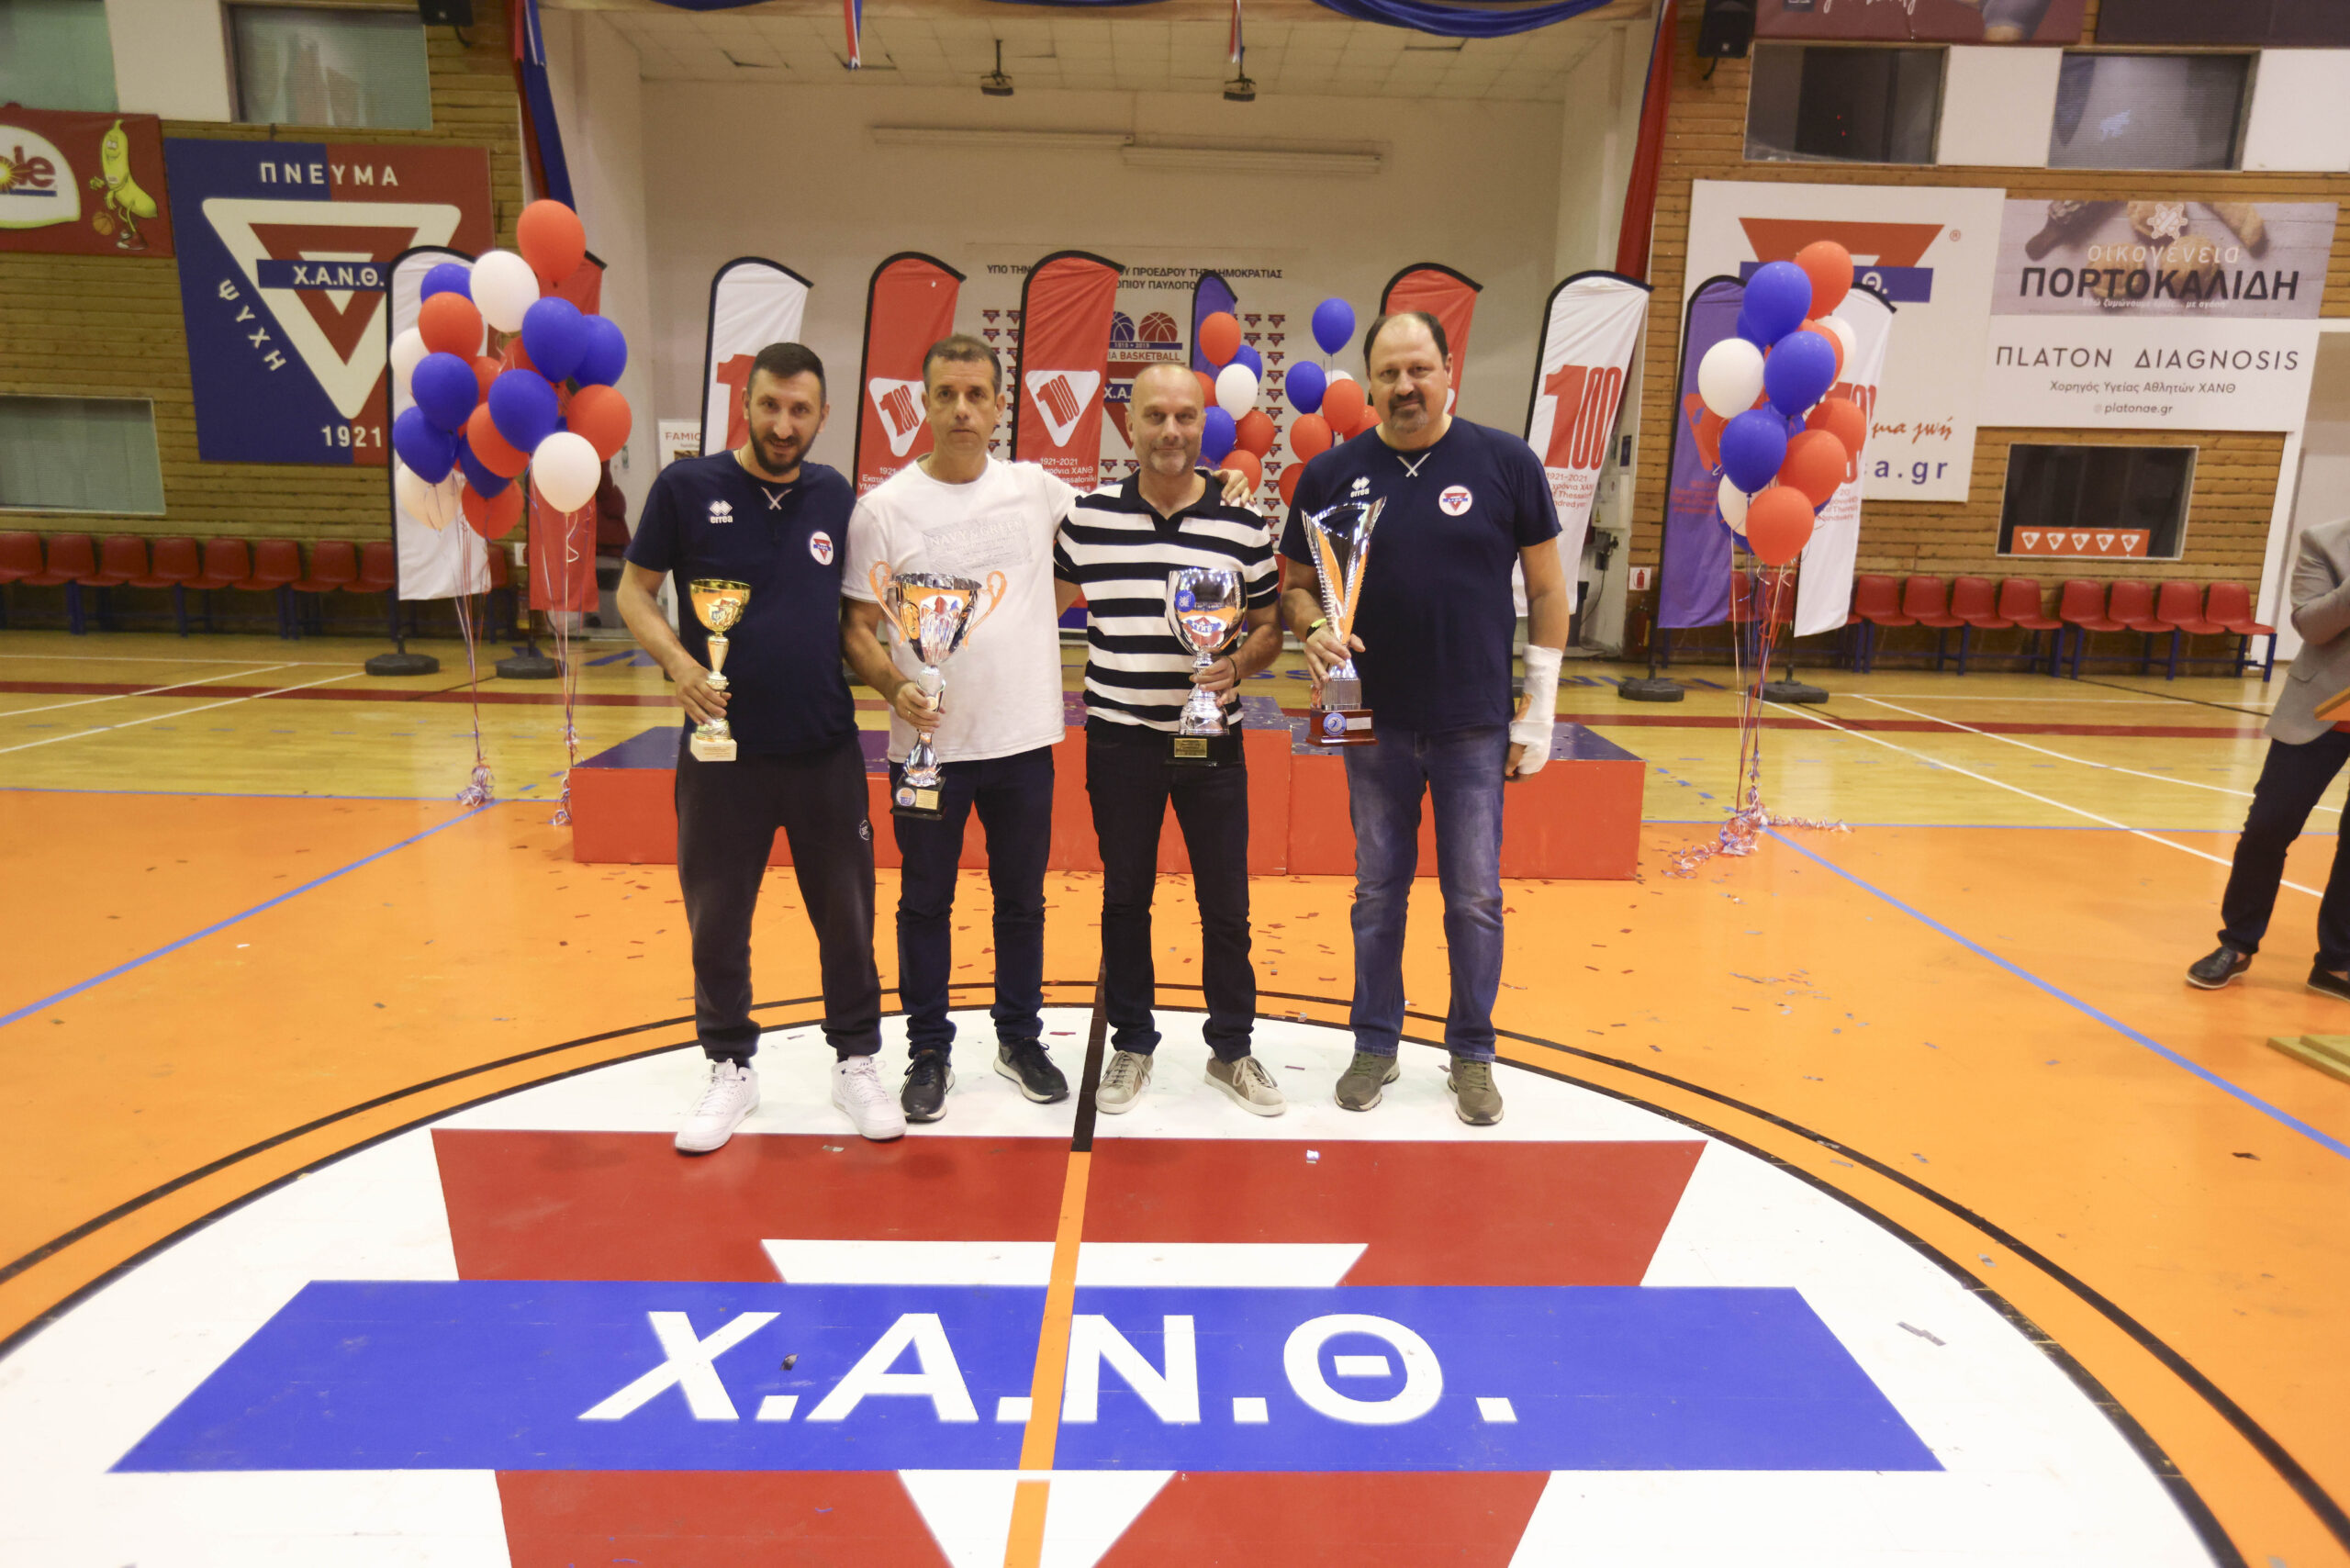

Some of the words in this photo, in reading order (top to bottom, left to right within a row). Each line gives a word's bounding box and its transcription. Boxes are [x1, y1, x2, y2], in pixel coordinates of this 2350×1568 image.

[260, 162, 398, 186] ΠΝΕΥΜΑ
[987, 264, 1008, 274] ΥΠΟ
[1133, 267, 1186, 276] ΠΡΟΕΔΡΟΥ
[1216, 267, 1282, 278] ΗΜΟΚΡΑΤΙΑΣ
[1148, 280, 1196, 290] ΠΑΥΛΟΠΟ
[2020, 267, 2300, 300] ΠΟΡΤΟΚΑΛΙΔΗ
[218, 279, 287, 371] ΨΥΧΗ
[1120, 352, 1181, 362] BASKETBALL
[1104, 386, 1131, 399] Χ.Α.
[2049, 380, 2099, 394] Χορηγός
[2104, 381, 2140, 394] Υγείας
[2143, 381, 2195, 395] Αθλητών
[2198, 382, 2236, 394] ΧΑΝΘ
[2104, 402, 2173, 416] platonae.gr
[321, 424, 382, 448] 1921
[1072, 465, 1093, 475] ΧΑΝΘ
[1546, 472, 1588, 482] 1921-2021
